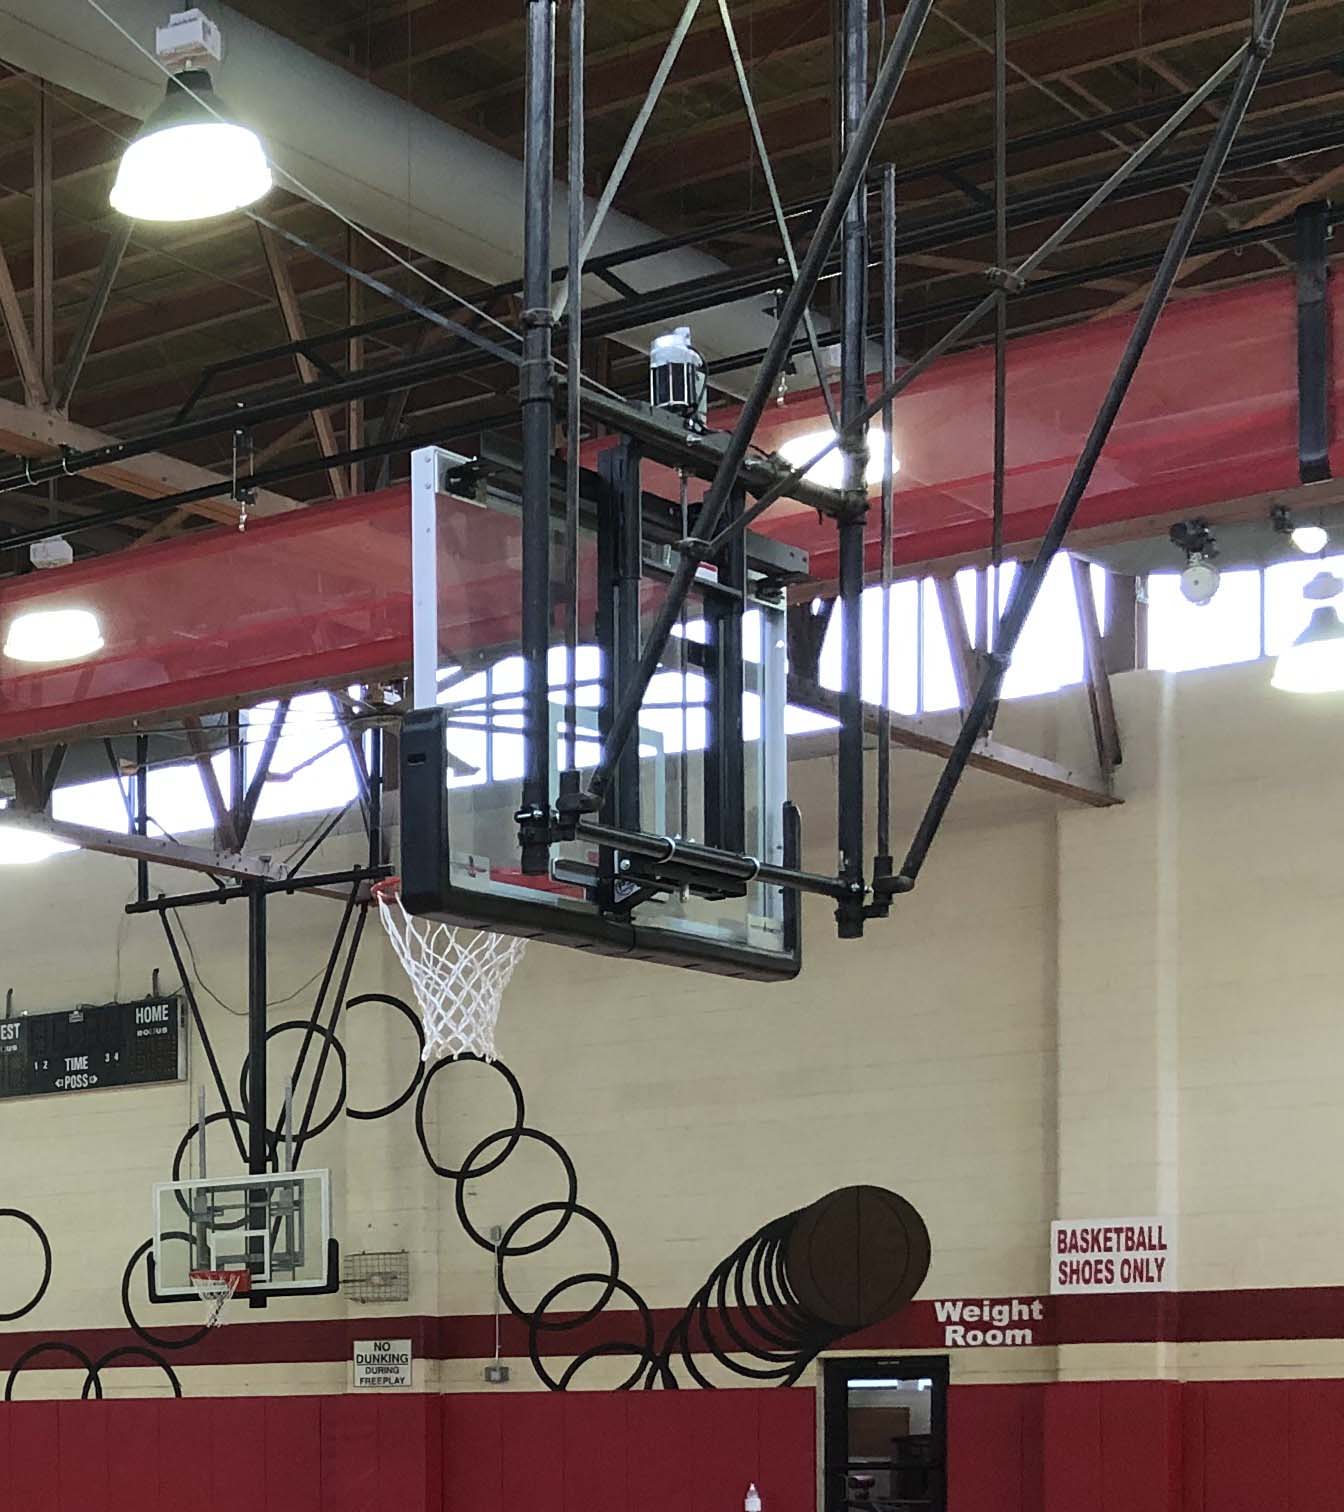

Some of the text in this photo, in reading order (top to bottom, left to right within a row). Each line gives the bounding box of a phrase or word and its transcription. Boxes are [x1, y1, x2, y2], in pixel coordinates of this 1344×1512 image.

[135, 1004, 169, 1024] HOME
[42, 1060, 48, 1070] 2
[64, 1055, 89, 1072] TIME
[104, 1052, 110, 1063] 3
[114, 1051, 119, 1061] 4
[64, 1073, 88, 1089] POSS
[1057, 1225, 1168, 1254] BASKETBALL
[1058, 1257, 1166, 1286] SHOES ONLY
[934, 1299, 1044, 1327] Weight
[944, 1325, 1033, 1346] Room
[373, 1341, 391, 1352] NO
[356, 1353, 409, 1364] DUNKING
[359, 1376, 405, 1385] FREEPLAY
[365, 1366, 400, 1375] DURING
